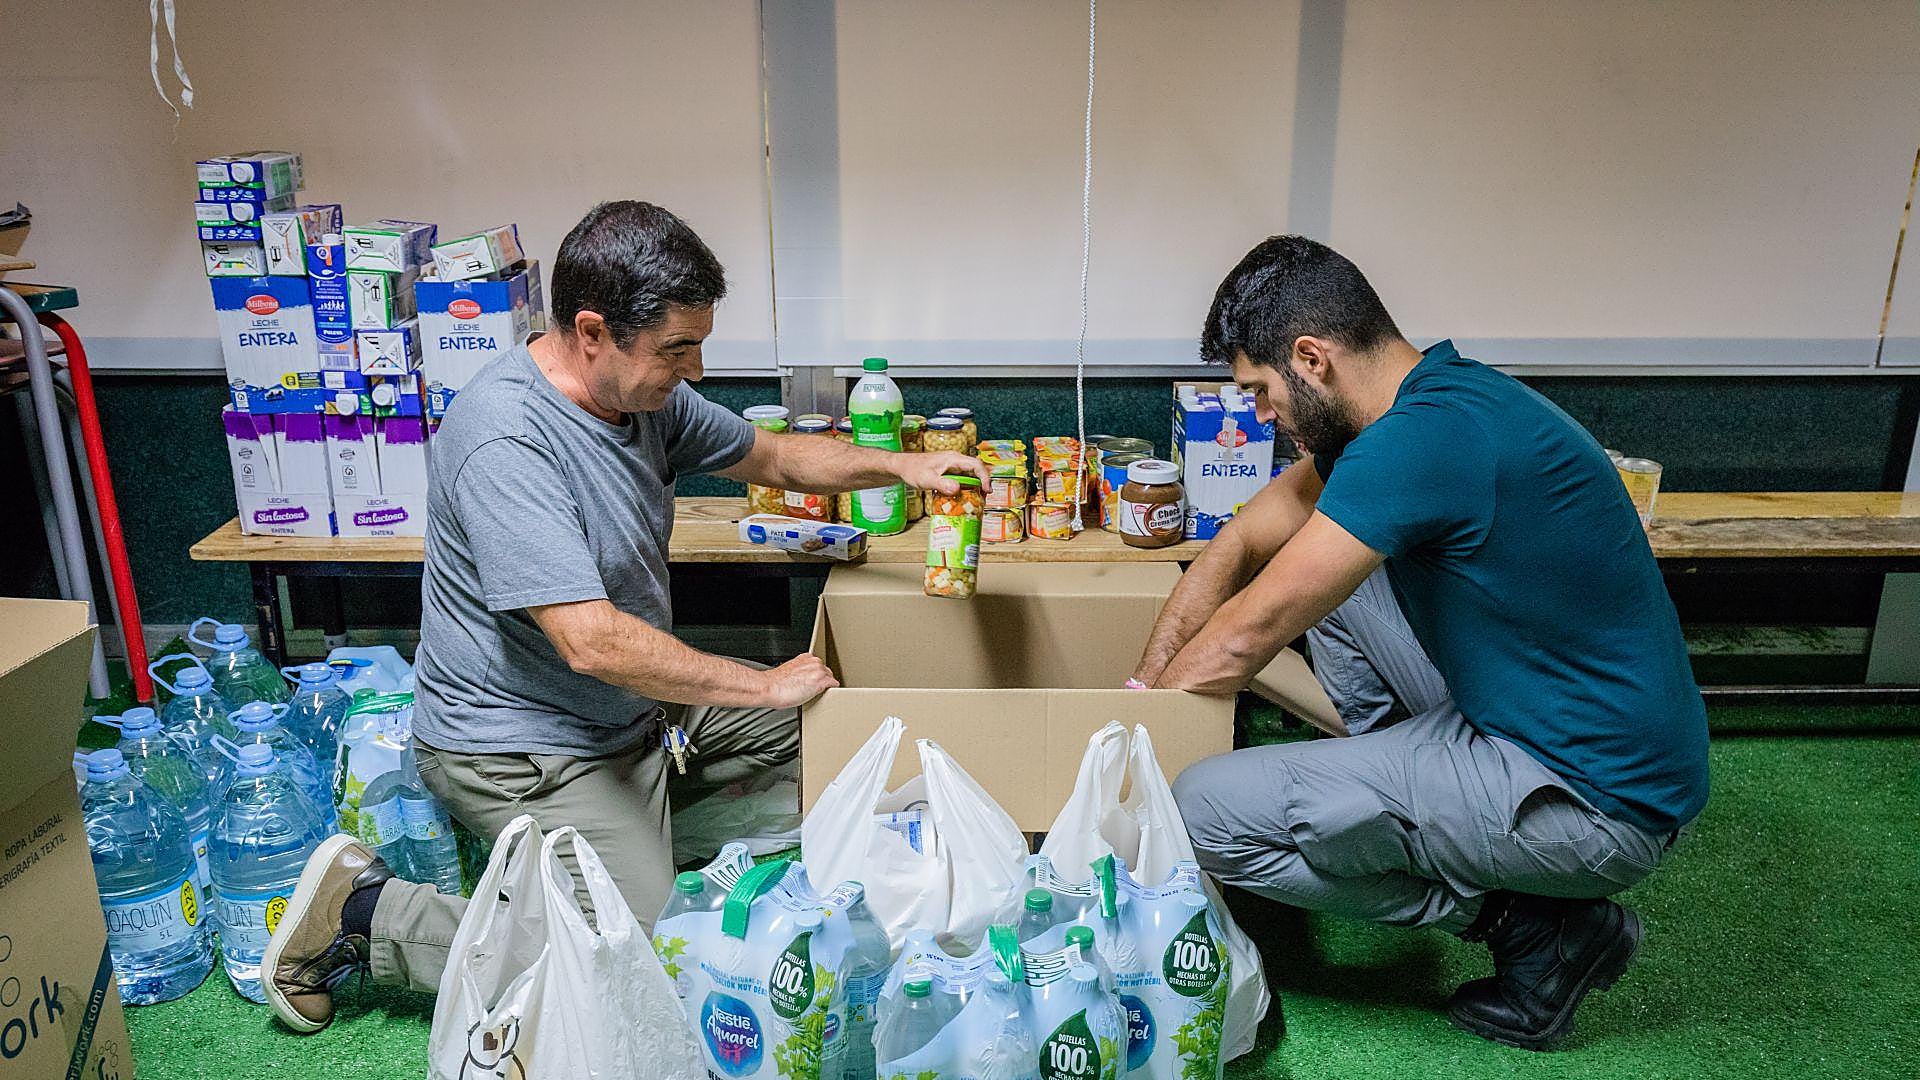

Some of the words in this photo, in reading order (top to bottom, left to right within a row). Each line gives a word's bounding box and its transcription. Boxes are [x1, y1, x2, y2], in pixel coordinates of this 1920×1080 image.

[247, 299, 279, 310] Milbona
[449, 303, 481, 313] Milbona
[252, 319, 280, 327] LECHE
[453, 323, 480, 331] LECHE
[239, 331, 298, 347] ENTERA
[439, 336, 497, 351] ENTERA
[1217, 451, 1244, 459] LHE
[1202, 463, 1257, 477] ENTERA
[257, 512, 273, 524] Sin
[272, 509, 305, 522] lactosa
[357, 513, 373, 525] Sin
[372, 511, 404, 524] lactosa
[4, 838, 27, 860] ROPA
[28, 813, 63, 843] LABORAL
[41, 832, 67, 856] TEXTIL
[1184, 932, 1208, 944] BOTELLAS
[785, 951, 806, 968] BOTELLAS
[1177, 970, 1199, 981] HECHAS
[1199, 973, 1207, 981] DE
[737, 983, 752, 992] MUY
[1169, 976, 1187, 987] OTRAS
[1187, 979, 1213, 988] BOTELLAS
[788, 996, 796, 1004] DE
[706, 1014, 760, 1050] Aquarel
[1058, 1033, 1086, 1046] BOTELLAS
